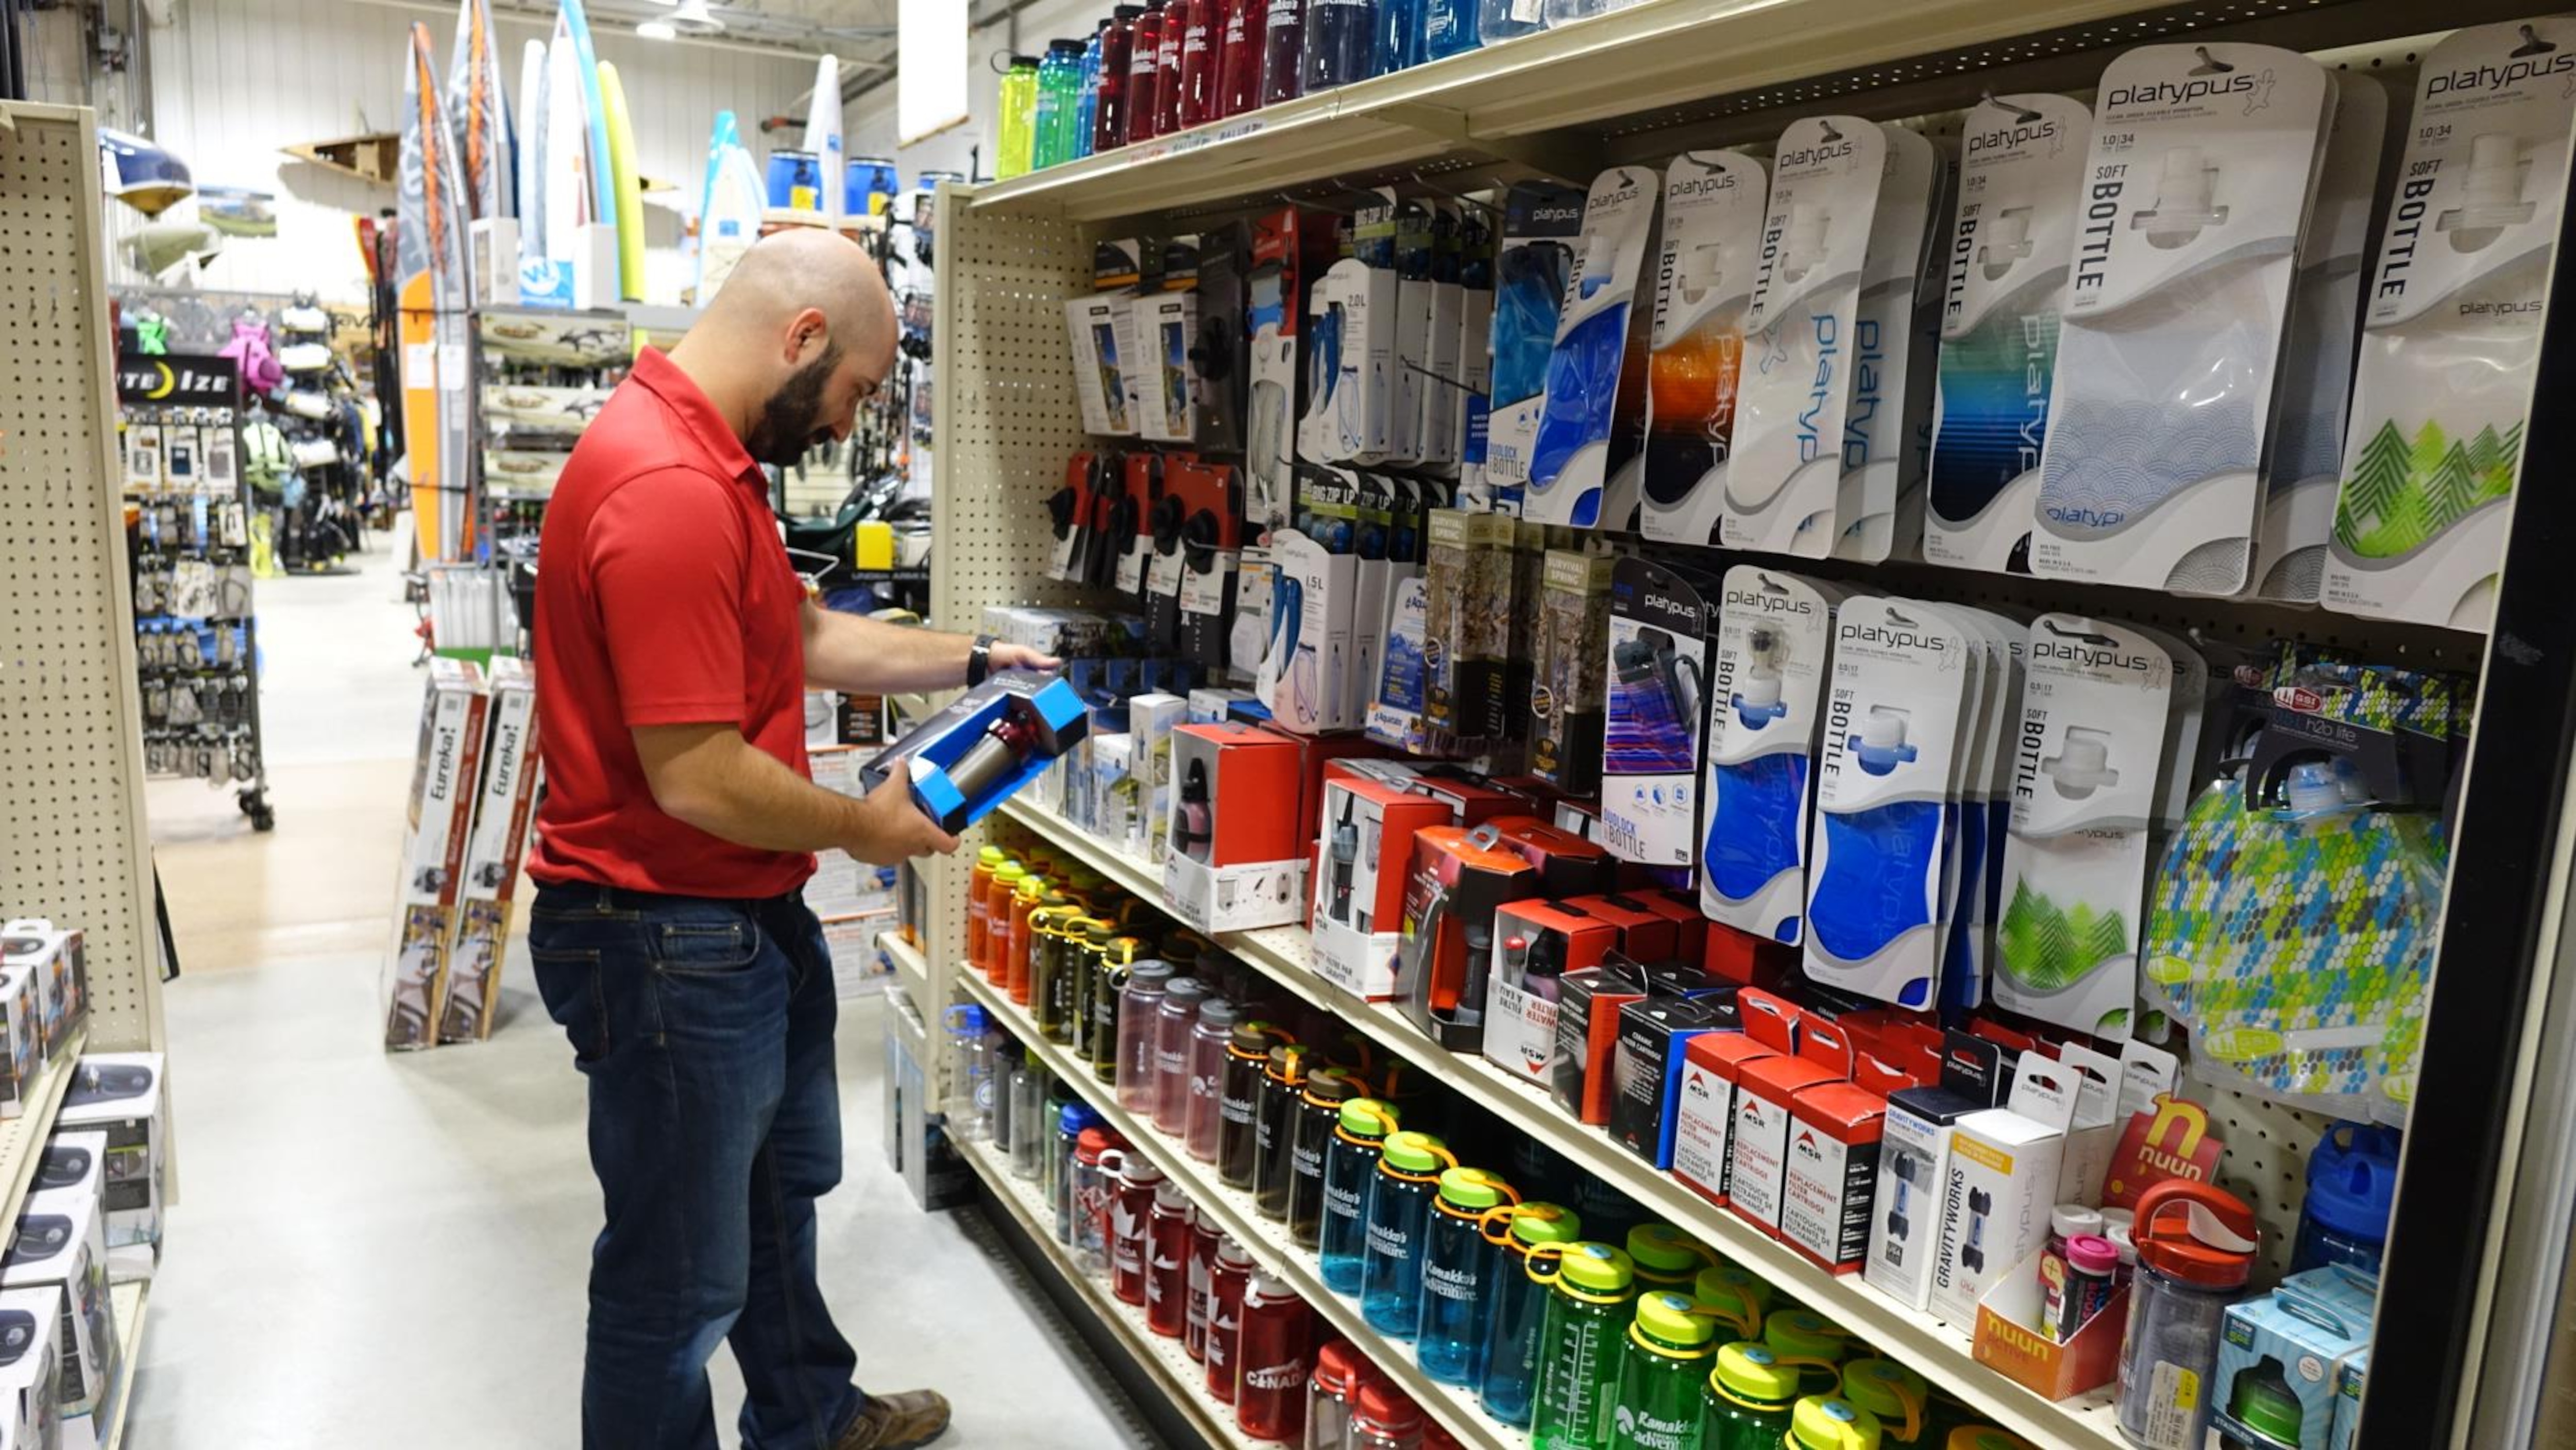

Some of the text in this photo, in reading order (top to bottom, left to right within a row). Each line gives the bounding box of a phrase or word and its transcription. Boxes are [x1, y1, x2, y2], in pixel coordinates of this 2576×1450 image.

[2427, 53, 2575, 99] platypus
[2108, 75, 2253, 109] platypus
[1969, 122, 2054, 154] platypus
[1780, 142, 1852, 170] platypus
[2410, 160, 2443, 175] SOFT
[2096, 164, 2127, 179] SOFT
[1589, 188, 1639, 209] platypus
[1669, 175, 1735, 199] platypus
[1533, 208, 1579, 222] platypus
[1770, 215, 1787, 227] SOFT
[1962, 204, 1981, 216] SOFT
[2076, 181, 2123, 290] BOTTLE
[2379, 179, 2435, 298] BOTTLE
[1751, 229, 1782, 315] BOTTLE
[1947, 219, 1977, 315] BOTTLE
[1654, 252, 1676, 332] BOTTLE
[2460, 301, 2543, 316] platypus
[118, 372, 155, 389] TE
[1326, 486, 1340, 503] ZIP
[1343, 490, 1355, 504] LP
[1551, 569, 1580, 585] SPRING
[1645, 594, 1696, 618] platypus
[1726, 591, 1810, 614] platypus
[1841, 623, 1944, 650] platypus
[1722, 650, 1737, 660] SOFT
[2034, 642, 2148, 670] platypus
[1714, 660, 1735, 730] BOTTLE
[1835, 688, 1854, 701] SOFT
[2027, 709, 2048, 720] SOFT
[1825, 701, 1851, 777] BOTTLE
[430, 726, 456, 801] Eureka!
[494, 724, 519, 797] Eureka!
[2016, 721, 2044, 799] BOTTLE
[1609, 827, 1646, 861] BOTTLE
[1527, 1010, 1556, 1027] WATER
[1521, 1045, 1546, 1060] MSR
[1690, 1085, 1709, 1100] MSR
[1682, 1110, 1721, 1138] REPLACEMENT
[1744, 1113, 1765, 1128] MSR
[1888, 1108, 1935, 1136] GRAVITYWORKS
[1737, 1140, 1779, 1169] REPLACEMENT
[1798, 1143, 1822, 1162] MSR
[2138, 1145, 2202, 1182] nuun
[1789, 1170, 1837, 1204] REPLACEMENT
[1788, 1188, 1825, 1215] CARTRIDGE
[1787, 1206, 1826, 1236] CARTOUCHE
[1936, 1168, 1964, 1288] GRAVITYWORKS
[1987, 1312, 2048, 1361] nuun
[1246, 1371, 1300, 1389] CANAD
